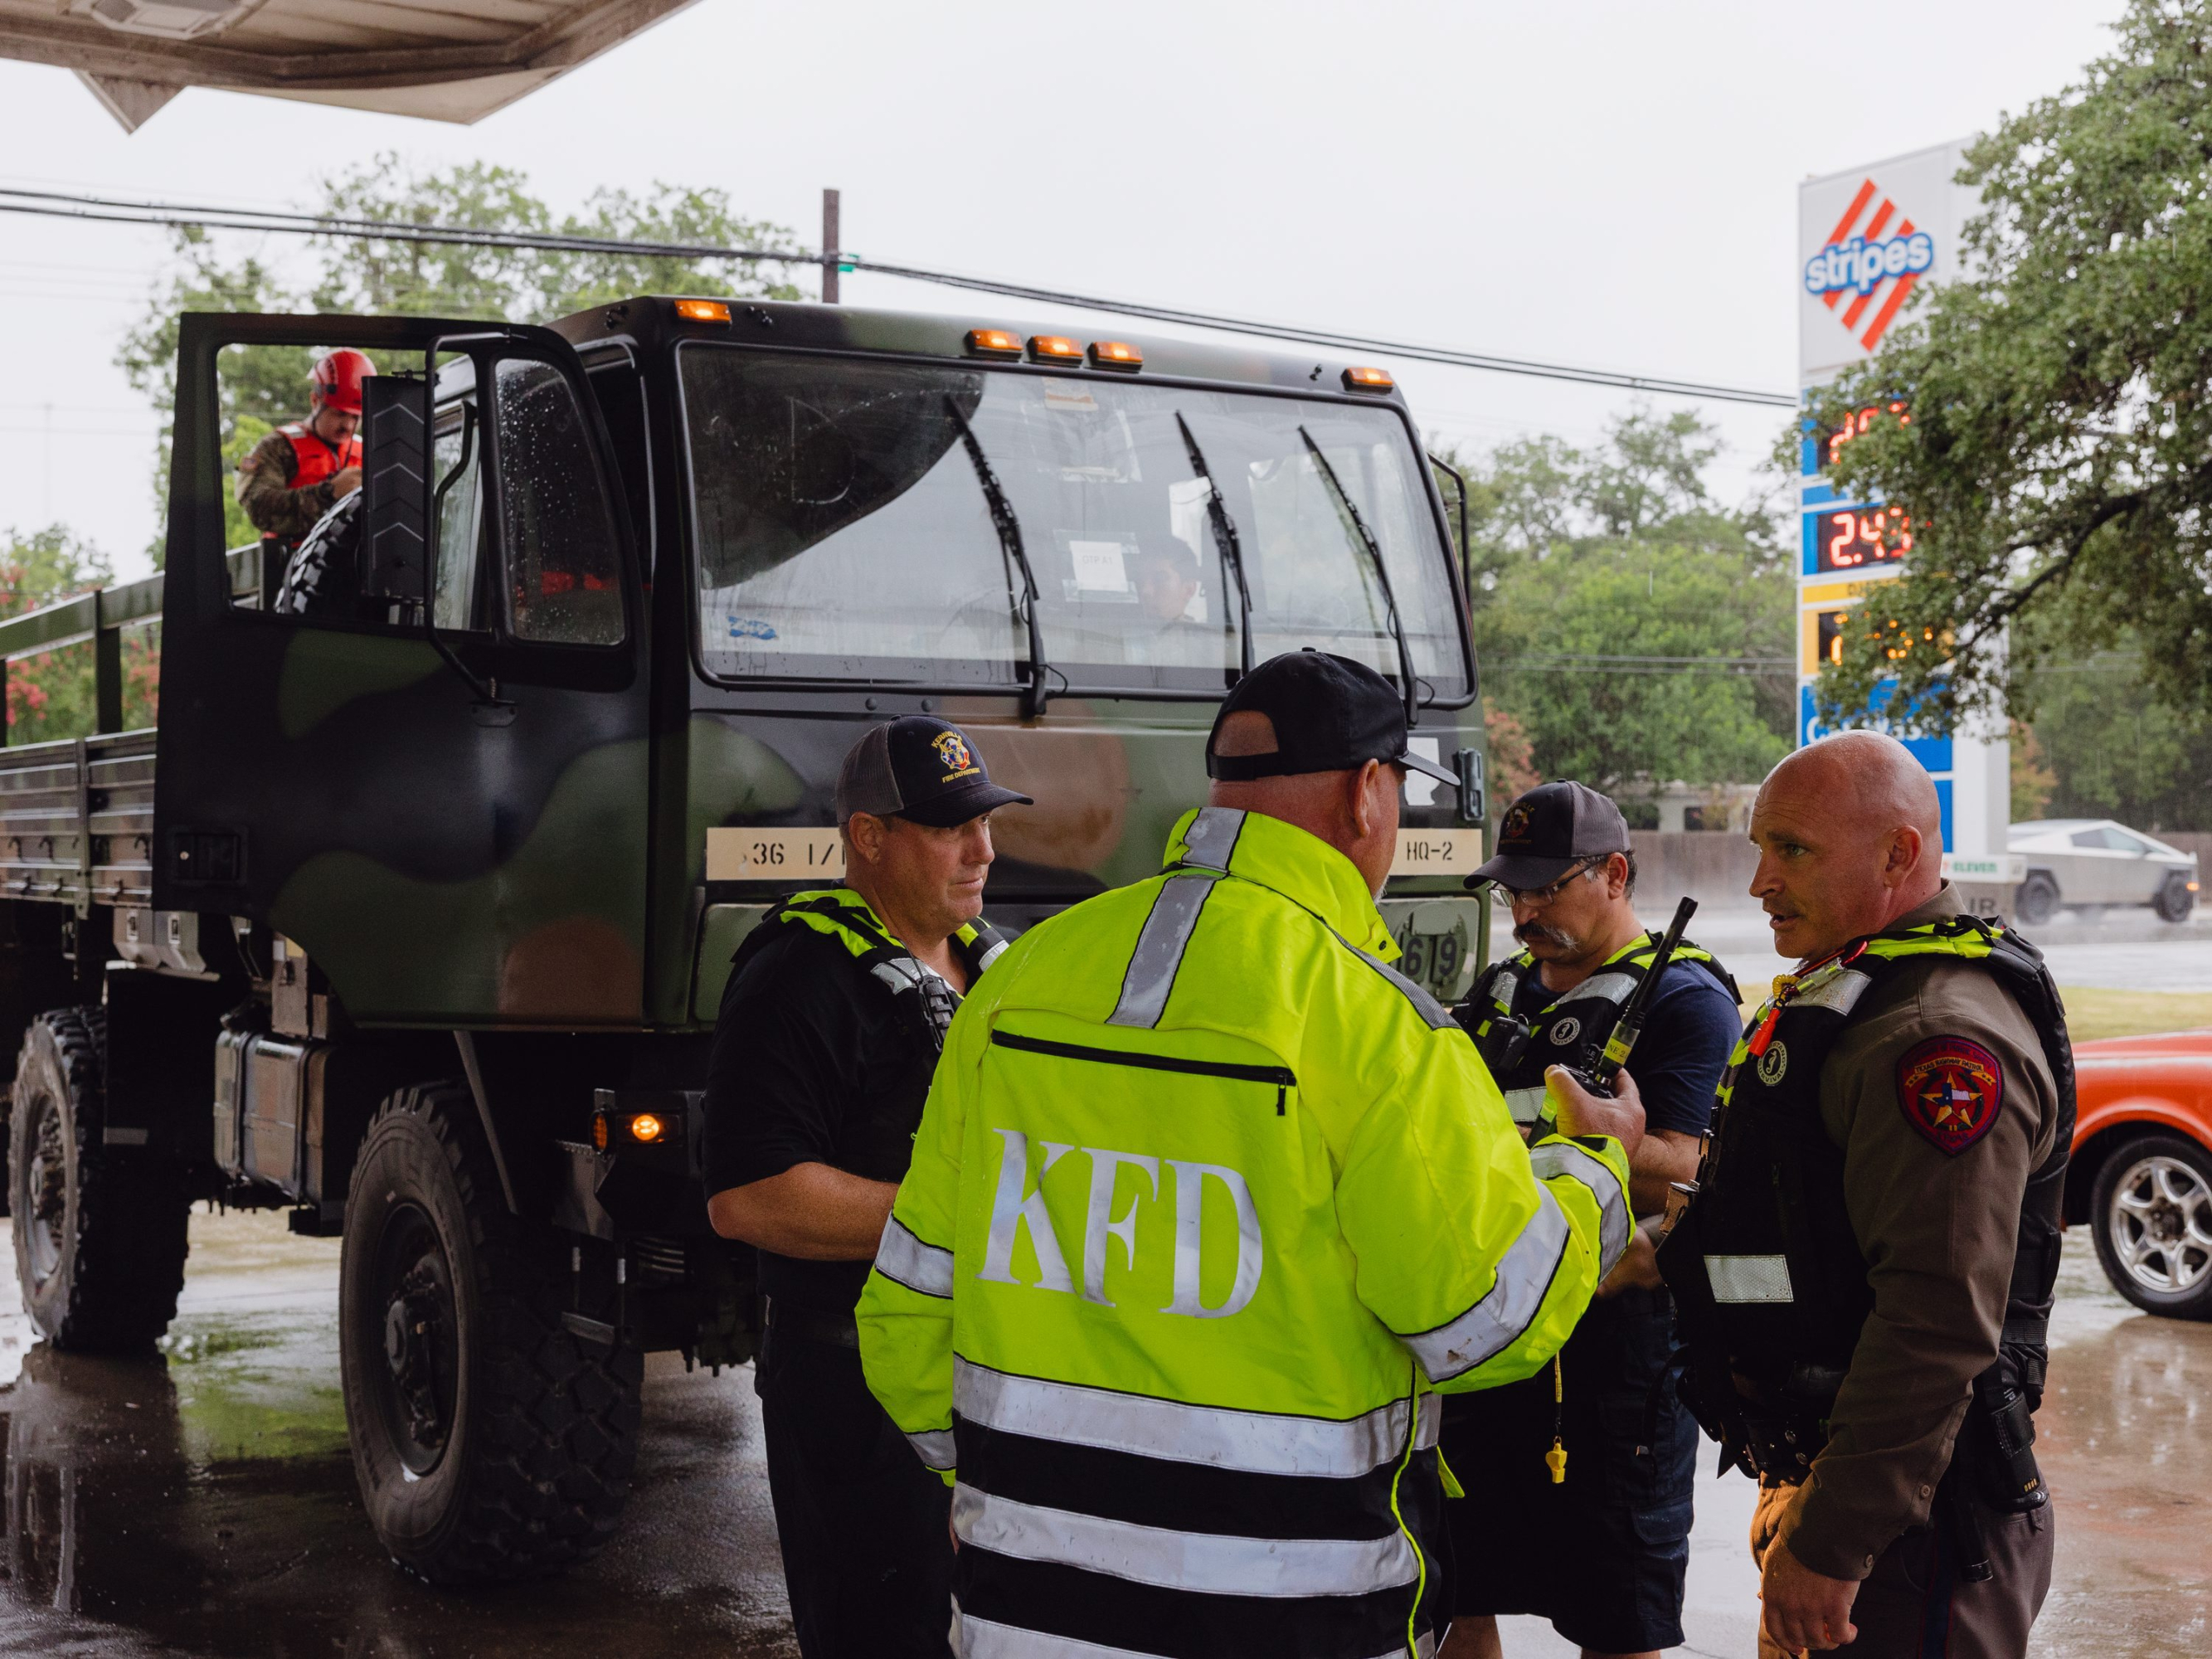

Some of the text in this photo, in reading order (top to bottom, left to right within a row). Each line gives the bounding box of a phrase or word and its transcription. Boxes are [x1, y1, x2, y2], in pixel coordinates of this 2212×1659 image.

[1806, 234, 1932, 294] stripes
[941, 773, 955, 784] FIRE
[753, 843, 785, 865] 36
[1407, 840, 1453, 861] HQ-2
[1916, 1062, 1935, 1073] TEXAS
[1936, 1058, 1961, 1066] HIGHWAY
[1962, 1060, 1983, 1071] PATROL
[975, 1128, 1263, 1318] KFD
